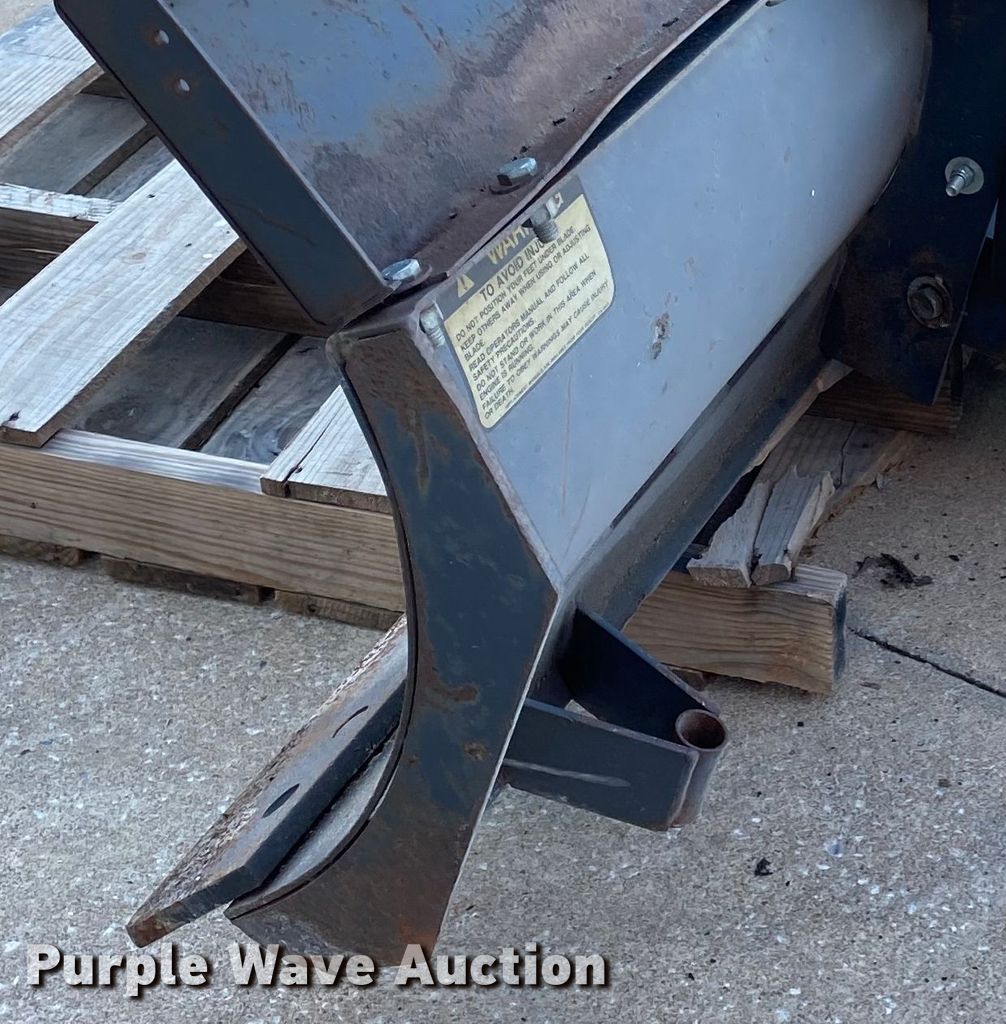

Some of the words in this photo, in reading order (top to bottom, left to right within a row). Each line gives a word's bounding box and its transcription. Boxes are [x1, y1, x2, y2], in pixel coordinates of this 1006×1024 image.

[454, 327, 466, 343] DO
[464, 314, 479, 333] NOT
[478, 288, 507, 320] POSITION
[506, 273, 524, 294] YOUR
[522, 259, 537, 279] FEET
[537, 241, 557, 265] UNDER
[459, 332, 477, 353] KEEP
[476, 309, 501, 337] OTHERS
[500, 292, 518, 313] AWAY
[517, 275, 536, 297] WHEN
[535, 258, 553, 280] USING
[552, 250, 562, 264] OR
[561, 222, 591, 255] ADJUSTING
[467, 351, 486, 373] READ
[484, 317, 521, 356] OPERATORS
[519, 294, 544, 322] MANUAL
[543, 282, 556, 299] AND
[555, 260, 578, 287] FOLLOW
[577, 249, 589, 265] ALL
[478, 280, 495, 304] TO
[494, 253, 524, 289] AVOID
[471, 354, 496, 382] SAFETY
[475, 376, 487, 392] DO
[485, 364, 499, 382] NOT
[498, 344, 519, 369] STAND
[518, 335, 529, 350] OR
[528, 318, 546, 340] WORK
[545, 311, 553, 323] IN
[552, 298, 566, 315] THIS
[564, 283, 580, 303] AREA
[580, 268, 596, 288] WHEN
[481, 382, 507, 412] FAILURE
[505, 373, 516, 387] TO
[514, 357, 532, 378] OBEY
[531, 328, 560, 361] WARNINGS
[559, 314, 573, 332] MAY
[572, 297, 591, 320] CAUSE
[589, 278, 609, 302] INJURY
[478, 375, 501, 401] ENGINE
[500, 368, 508, 379] IS
[483, 406, 494, 420] OR
